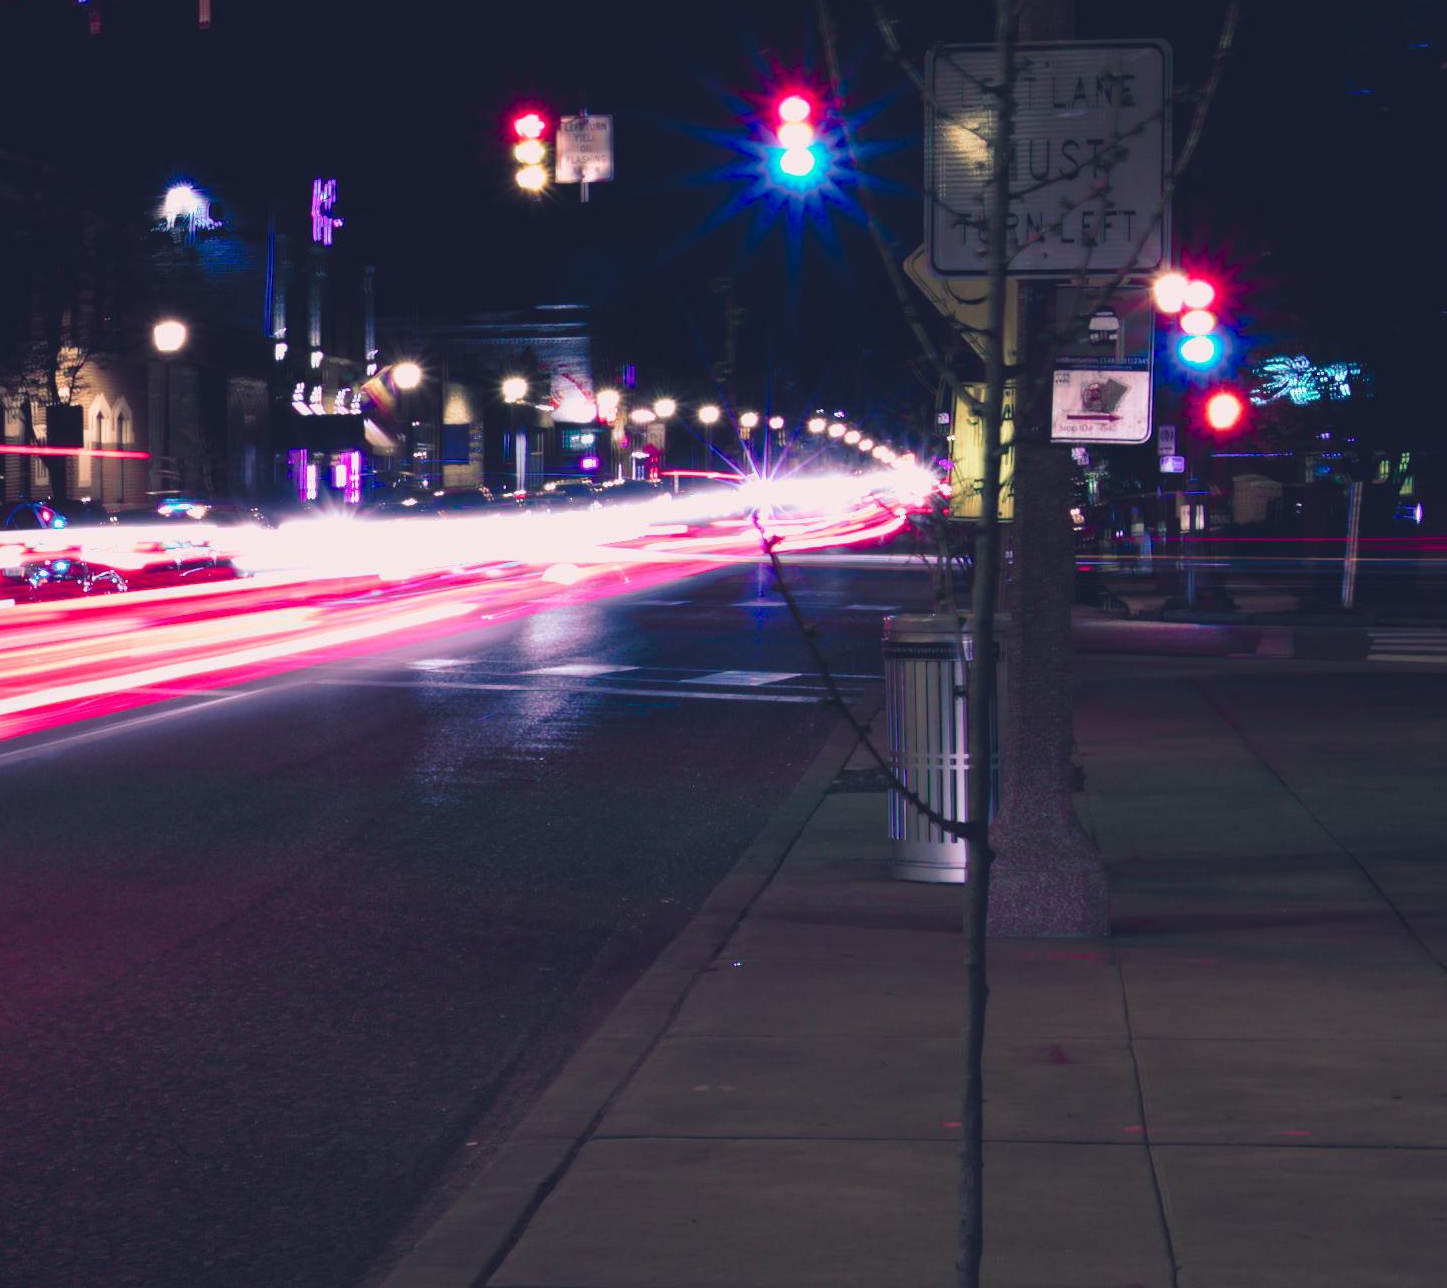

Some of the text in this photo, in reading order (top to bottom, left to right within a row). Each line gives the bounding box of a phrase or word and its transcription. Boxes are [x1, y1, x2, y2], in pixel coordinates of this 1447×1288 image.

[961, 74, 1136, 110] LET LANE
[1060, 210, 1137, 244] LEFT
